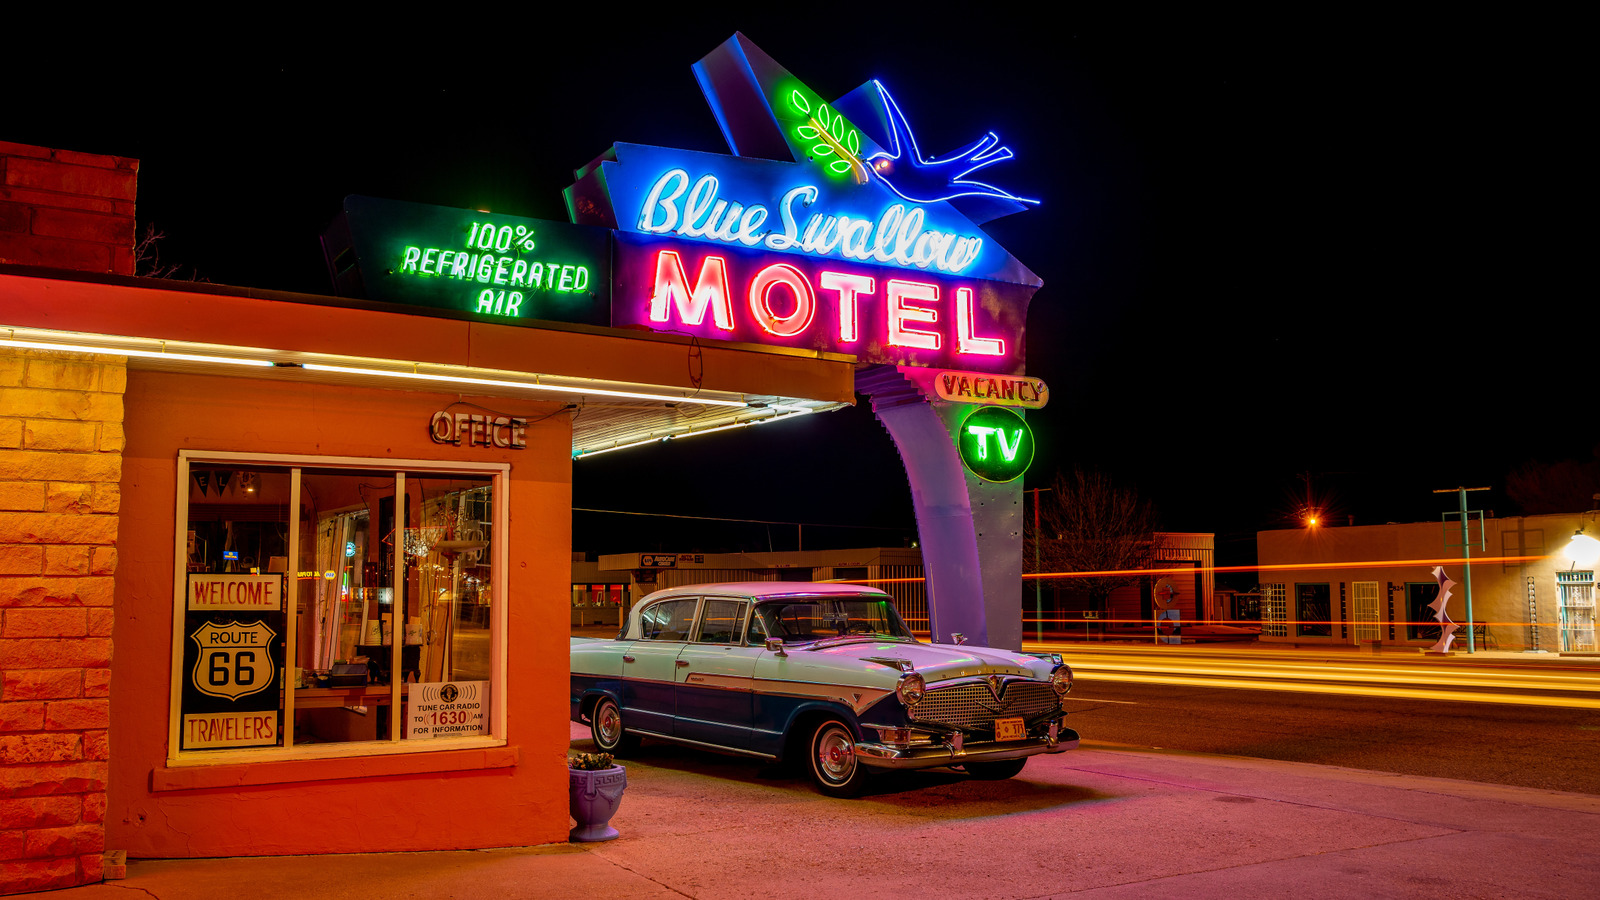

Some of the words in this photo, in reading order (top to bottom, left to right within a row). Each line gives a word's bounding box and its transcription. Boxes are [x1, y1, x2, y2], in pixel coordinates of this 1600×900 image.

[637, 168, 769, 248] Blue
[765, 185, 984, 273] Swallow
[466, 222, 536, 252] 100%
[402, 246, 590, 294] REFRIGERATED
[475, 288, 524, 317] AIR
[649, 250, 1006, 357] MOTEL
[942, 374, 1045, 402] VACANCY
[429, 410, 528, 449] OFFICE
[967, 425, 1023, 462] TV
[194, 581, 274, 605] WELCOME
[210, 631, 258, 644] ROUTE
[208, 651, 256, 686] 66
[430, 711, 467, 725] 1630
[440, 703, 455, 711] CAR
[456, 702, 480, 710] RADIO
[188, 716, 273, 743] TRAVELERS
[413, 727, 429, 735] FOR
[432, 724, 483, 733] INFORMATION
